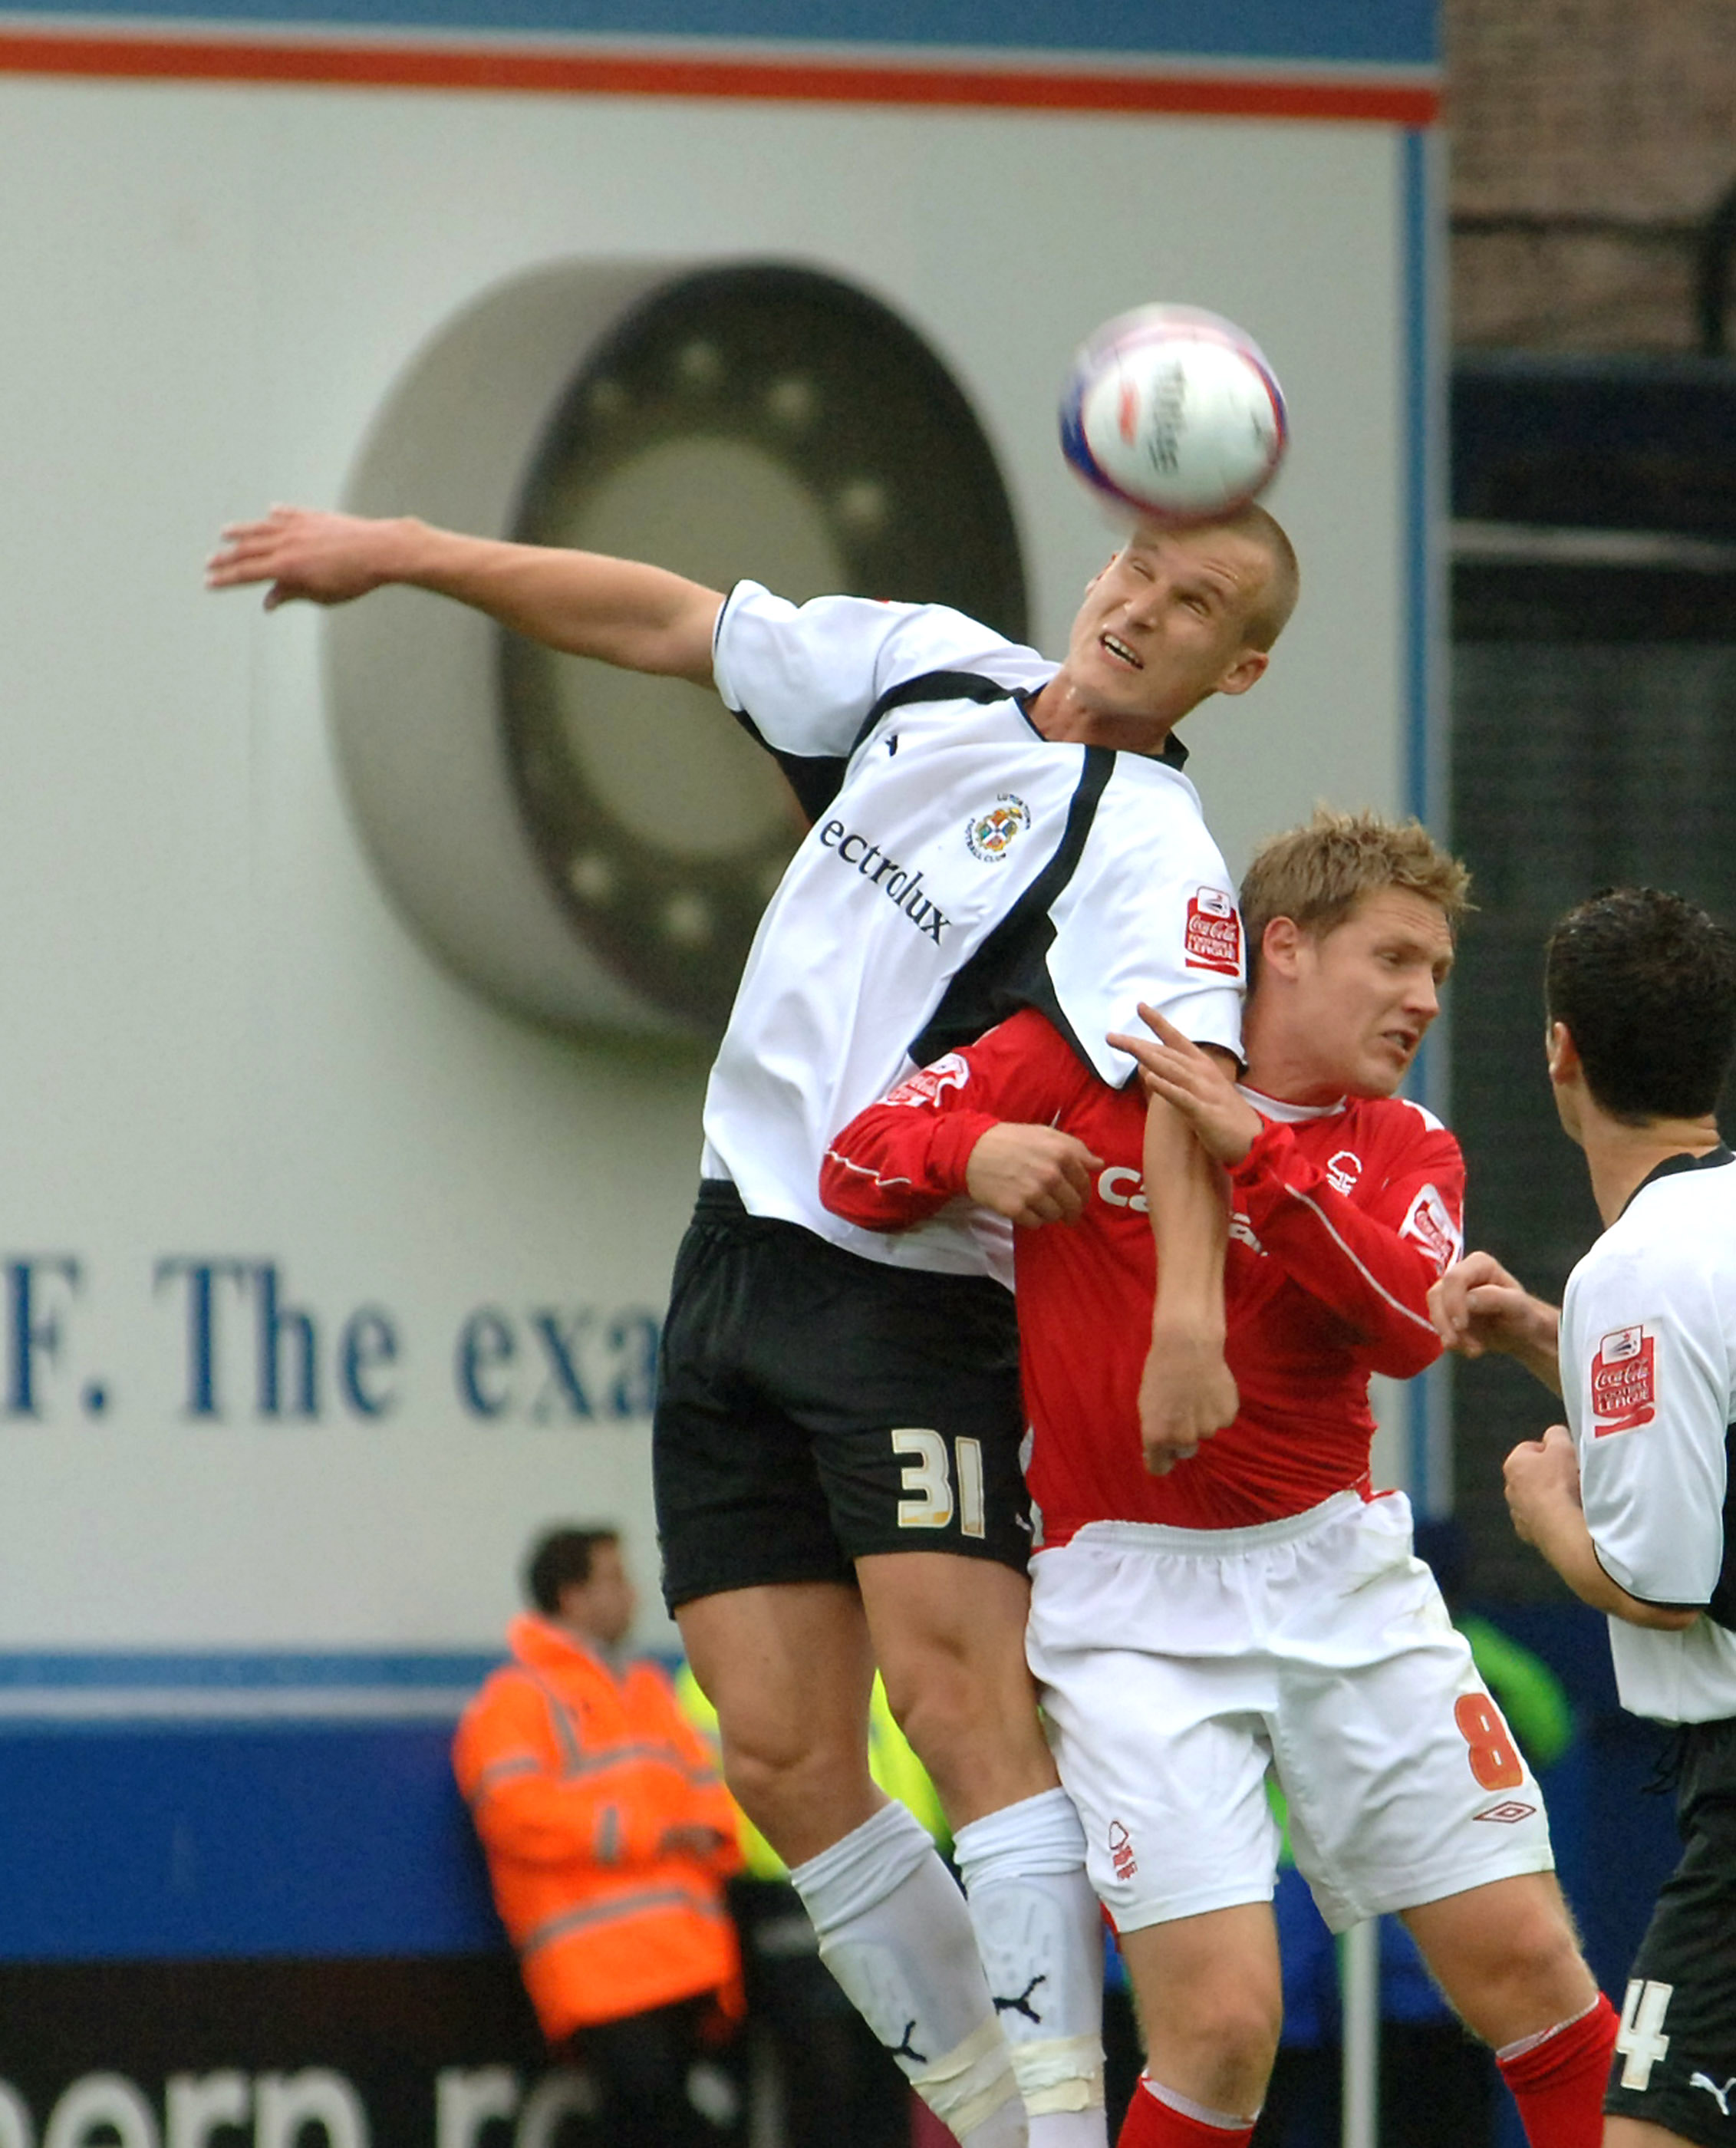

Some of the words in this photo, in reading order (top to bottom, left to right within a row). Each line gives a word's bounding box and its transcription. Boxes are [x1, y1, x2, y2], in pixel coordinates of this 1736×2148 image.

[153, 1255, 400, 1421] The
[891, 1428, 985, 1540] 31
[1454, 1692, 1524, 1791] 8
[1616, 1978, 1674, 2092] 4
[0, 2070, 370, 2148] ern
